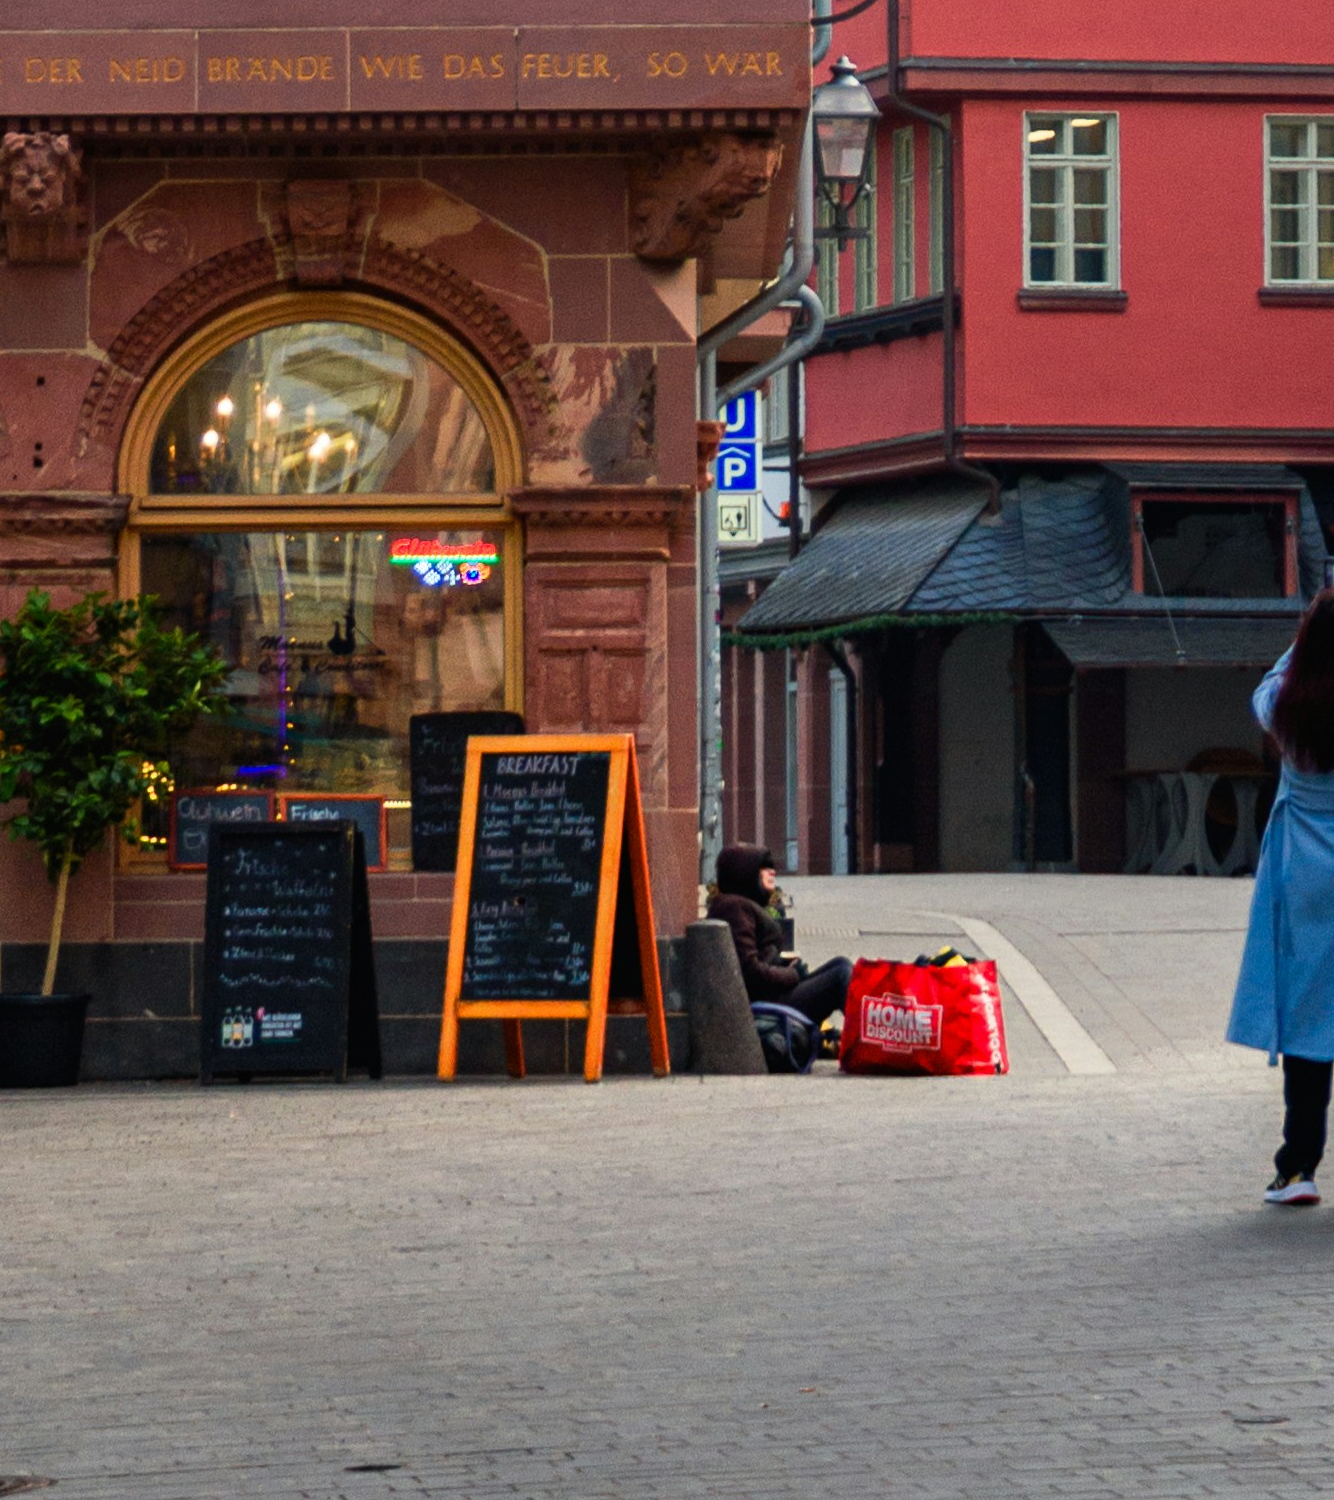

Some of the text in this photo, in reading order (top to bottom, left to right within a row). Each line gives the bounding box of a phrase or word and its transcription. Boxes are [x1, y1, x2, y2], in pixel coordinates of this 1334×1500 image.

[24, 58, 83, 84] DER
[109, 56, 185, 84] NEID
[207, 54, 334, 83] BRÄNDE
[361, 54, 424, 81] WIE
[442, 53, 507, 80] DAS
[647, 51, 689, 78] SO
[719, 398, 746, 433] U
[723, 457, 747, 487] P
[496, 755, 581, 776] BREAKFAST
[867, 1001, 932, 1033] HOME
[866, 1024, 932, 1045] DISCOUNT
